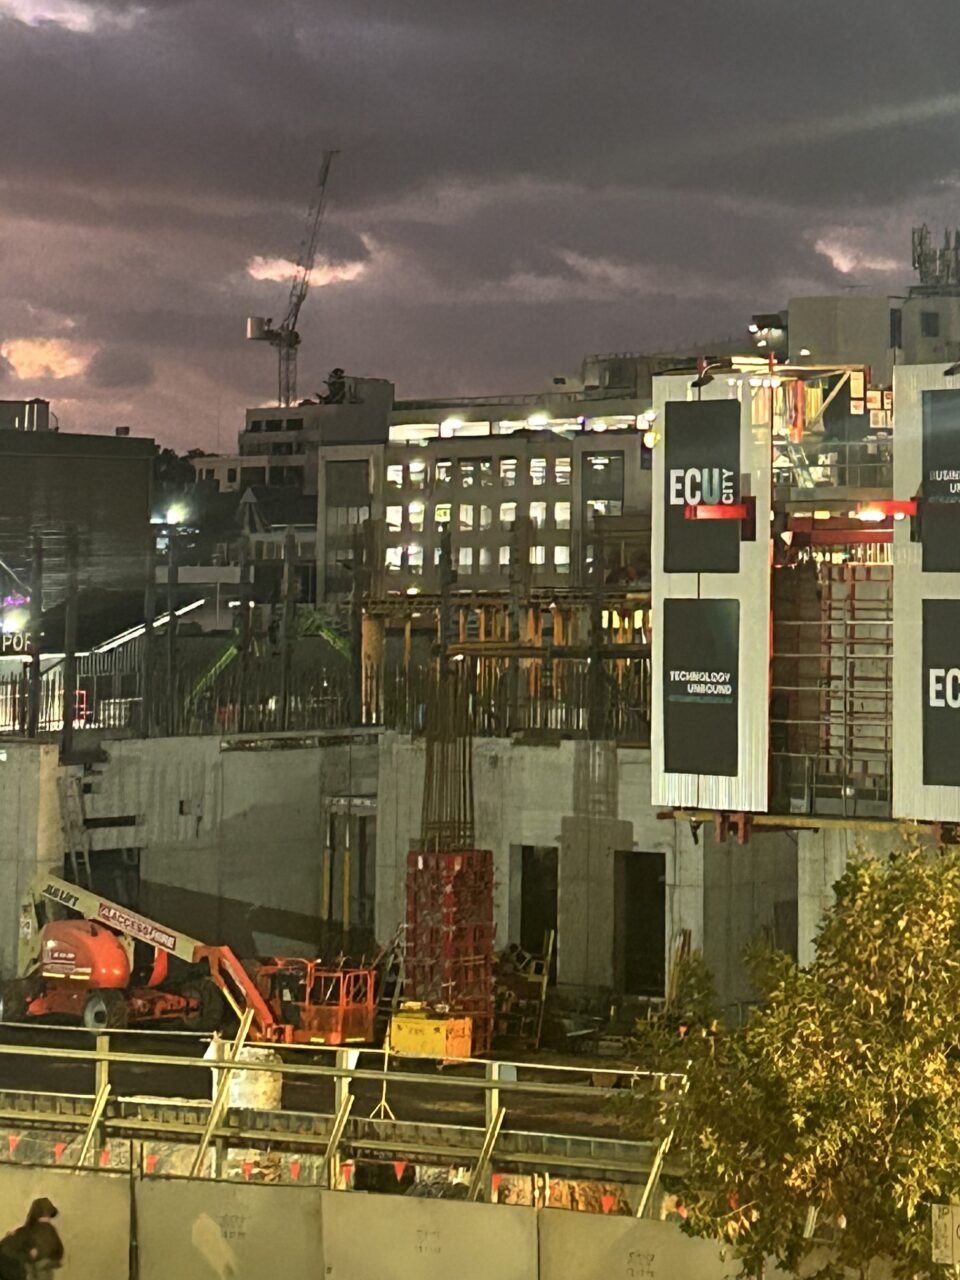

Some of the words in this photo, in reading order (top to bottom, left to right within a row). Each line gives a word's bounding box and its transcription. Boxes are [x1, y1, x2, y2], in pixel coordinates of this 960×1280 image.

[670, 467, 720, 506] ECU
[721, 468, 734, 505] CITY
[670, 670, 731, 682] TECHNOLOGY
[687, 683, 732, 695] UNBOUND
